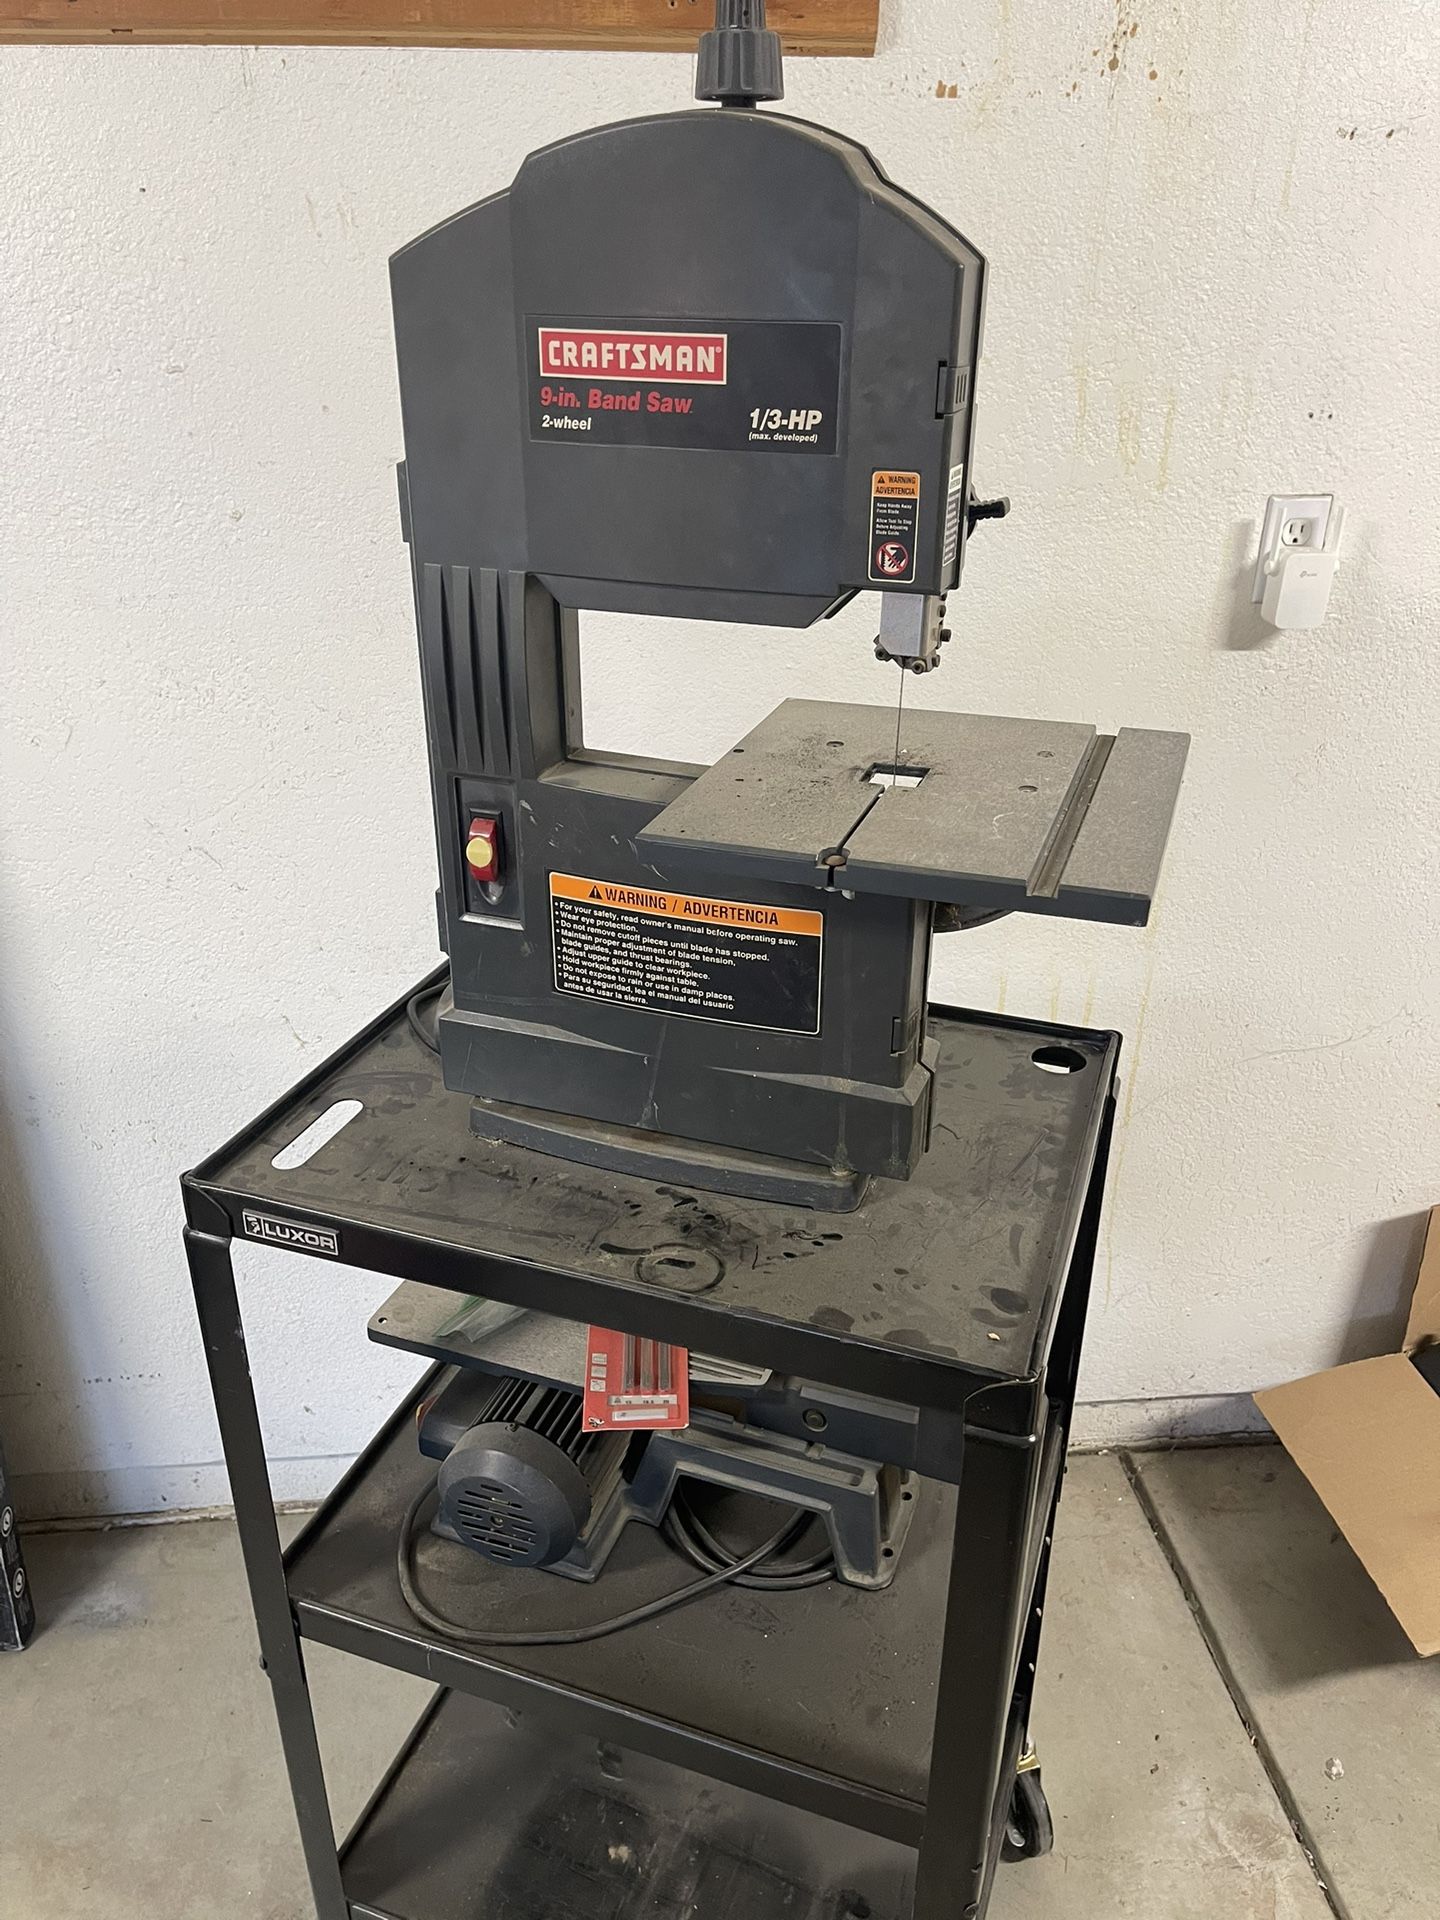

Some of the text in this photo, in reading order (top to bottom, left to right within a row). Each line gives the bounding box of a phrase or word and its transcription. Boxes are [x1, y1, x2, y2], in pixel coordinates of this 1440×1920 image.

[540, 386, 581, 408] 9-in.
[588, 388, 641, 411] Band
[541, 414, 592, 431] 2-wheel
[750, 407, 823, 431] 1/3-HP
[749, 431, 818, 443] (max. developed)
[876, 486, 916, 496] ADVERTENCIA
[888, 475, 916, 485] WARNING
[605, 887, 779, 925] WARNING / ADVERTENCIA
[560, 911, 638, 932] Wear eye protection.
[560, 902, 572, 910] For
[574, 905, 592, 915] your
[621, 915, 638, 924] read
[674, 924, 704, 934] manual
[735, 932, 776, 945] operating
[778, 938, 798, 946] saw.
[561, 920, 770, 961] Do not remove cutoff pieces until blade has stopped.
[561, 929, 593, 941] Maintain
[594, 935, 620, 947] proper
[622, 940, 666, 955] adjustment
[668, 946, 676, 956] of
[678, 948, 700, 960] blade
[562, 937, 582, 948] blade
[613, 948, 628, 958] and
[630, 952, 654, 962] thrust
[655, 956, 692, 969] bearings.
[562, 946, 710, 980] Adjust upper guide to clear workpiece.
[562, 955, 699, 987] Hold workpiece firmly against table.
[563, 964, 573, 972] Do
[575, 966, 588, 975] not
[589, 970, 616, 981] expose
[618, 974, 626, 982] to
[628, 977, 642, 986] rain
[655, 982, 670, 990] use
[672, 983, 680, 992] in
[681, 988, 704, 998] damp
[706, 991, 735, 1001] places.
[564, 972, 580, 982] Para
[634, 986, 647, 995] lea
[649, 988, 656, 996] el
[657, 991, 686, 1002] manual
[688, 997, 701, 1005] del
[702, 1000, 734, 1010] usuario
[564, 982, 648, 1004] antes de usar la sierra.
[264, 1222, 335, 1250] LUXOR
